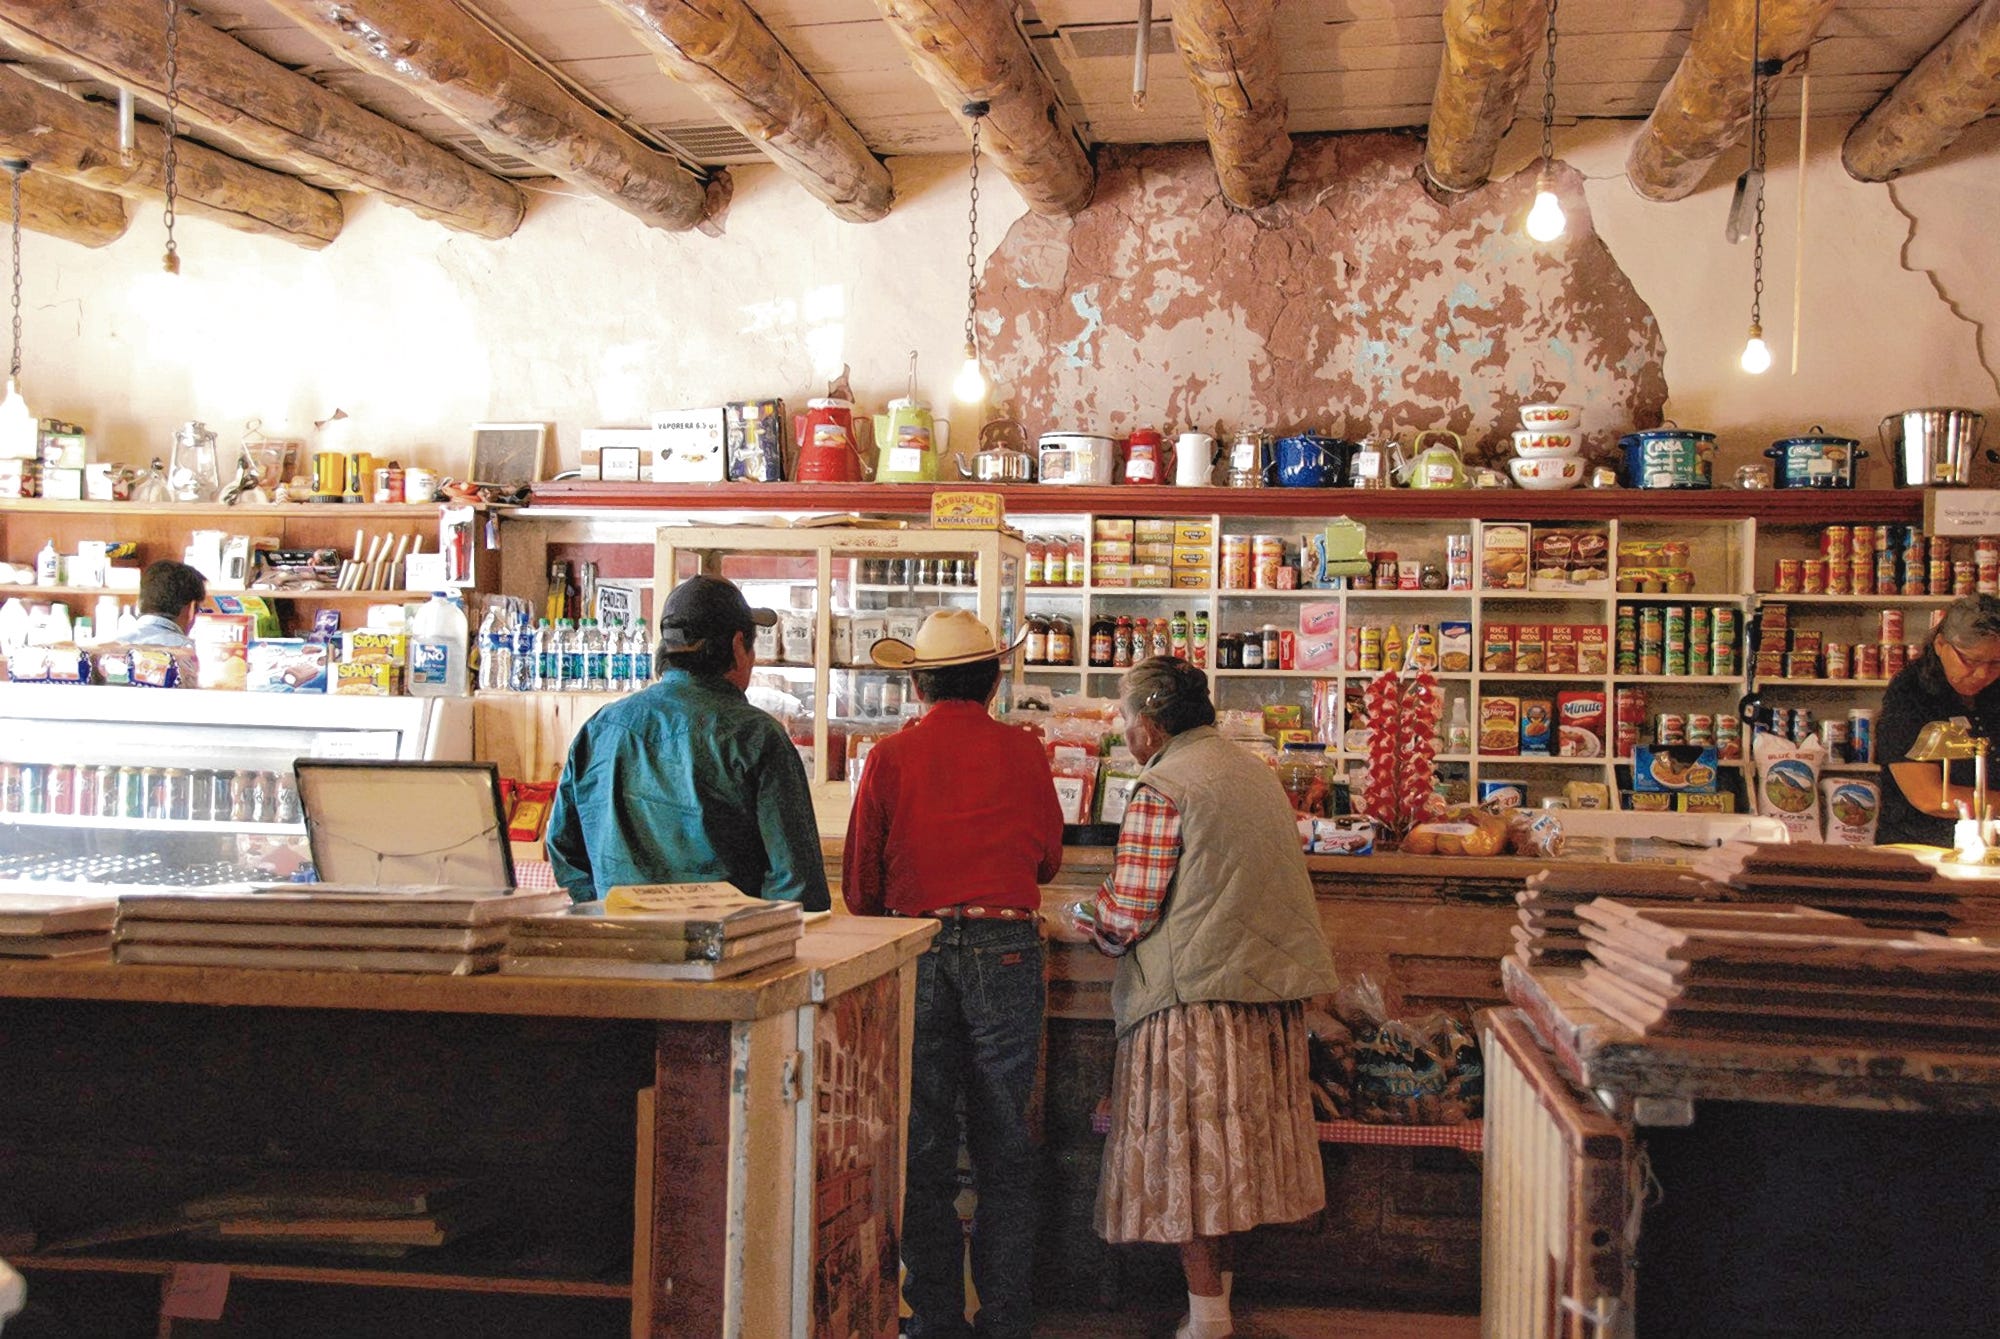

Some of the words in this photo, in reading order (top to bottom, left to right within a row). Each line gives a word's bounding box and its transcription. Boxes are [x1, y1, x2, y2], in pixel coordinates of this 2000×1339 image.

[966, 517, 994, 525] COFFEE
[353, 634, 392, 648] SPAM
[338, 664, 376, 677] SPAM
[1564, 702, 1602, 715] Minute
[1632, 794, 1667, 803] SPAM
[1688, 794, 1723, 804] SPAM
